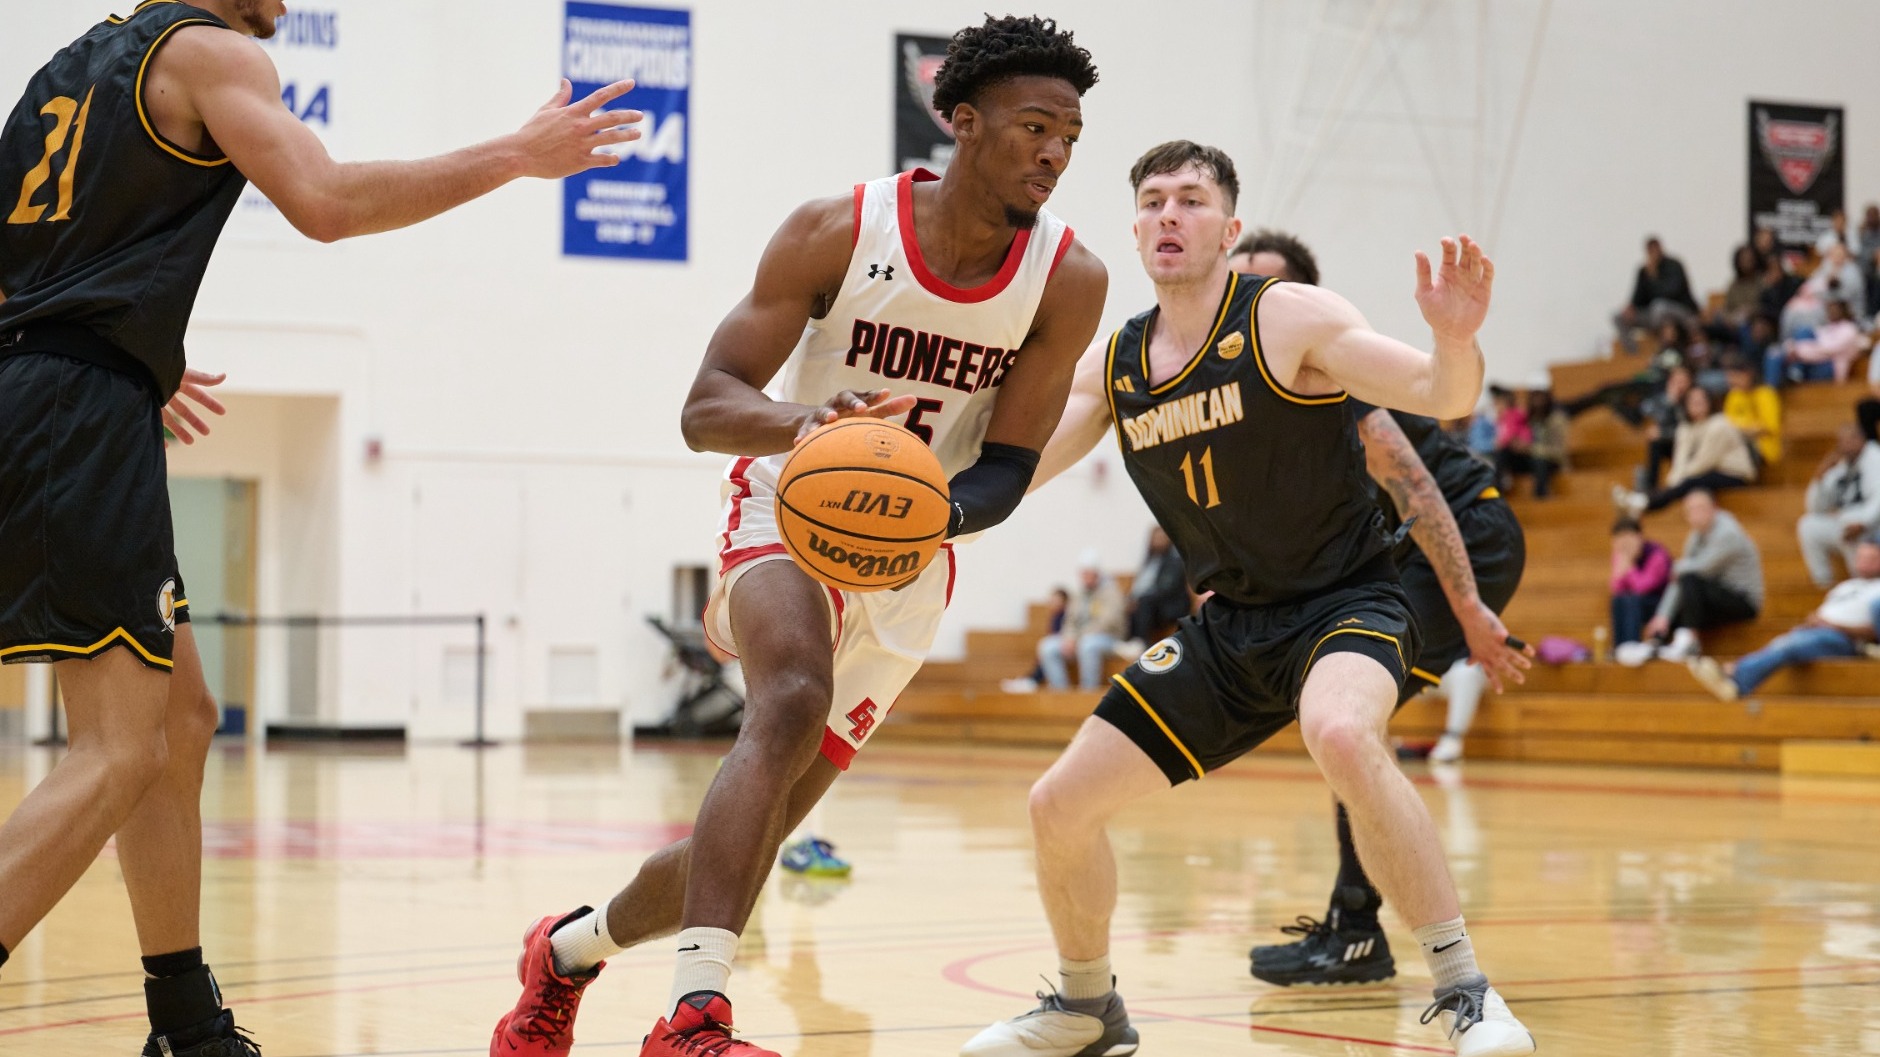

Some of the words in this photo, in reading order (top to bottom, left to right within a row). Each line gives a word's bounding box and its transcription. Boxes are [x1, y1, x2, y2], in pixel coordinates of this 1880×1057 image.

[7, 83, 96, 224] 21
[845, 318, 1019, 395] PIONEERS
[903, 397, 943, 446] 5
[1122, 381, 1244, 452] DOMINICAN
[819, 499, 841, 510] NXT
[842, 489, 913, 519] EVO
[1179, 444, 1221, 509] 11
[808, 531, 921, 577] Wilson
